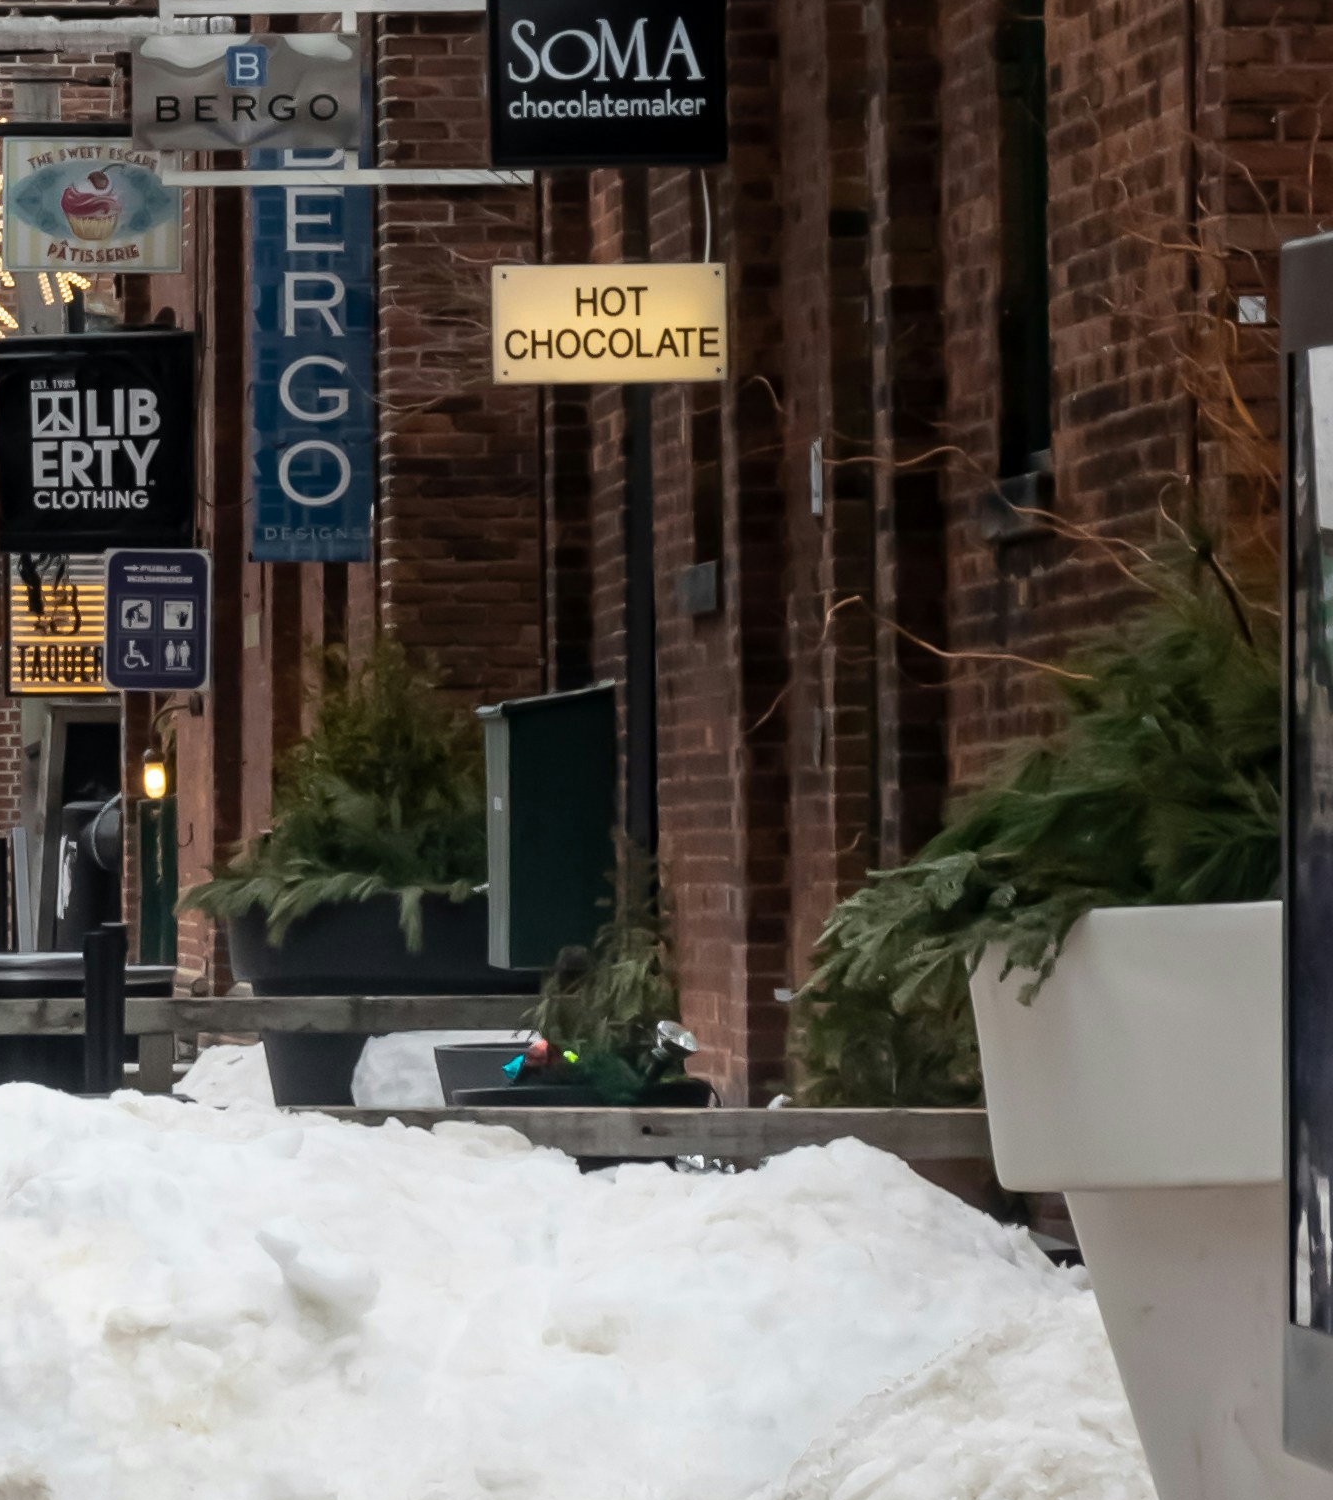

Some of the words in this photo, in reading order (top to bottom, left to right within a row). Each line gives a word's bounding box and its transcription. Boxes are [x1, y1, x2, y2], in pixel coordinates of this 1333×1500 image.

[508, 16, 706, 83] SOMA
[235, 53, 260, 80] B
[155, 94, 339, 121] BERGO
[508, 89, 706, 119] chocolatemaker
[27, 152, 54, 168] THE
[59, 147, 102, 161] SWEET
[109, 148, 157, 169] ESCAPE
[47, 240, 140, 263] PÂTISSERIE
[576, 286, 648, 317] HOT
[505, 327, 720, 360] CHOCOLATE
[86, 388, 161, 437] LIB
[33, 490, 149, 509] CLOTHING
[264, 527, 364, 541] DESIGNS
